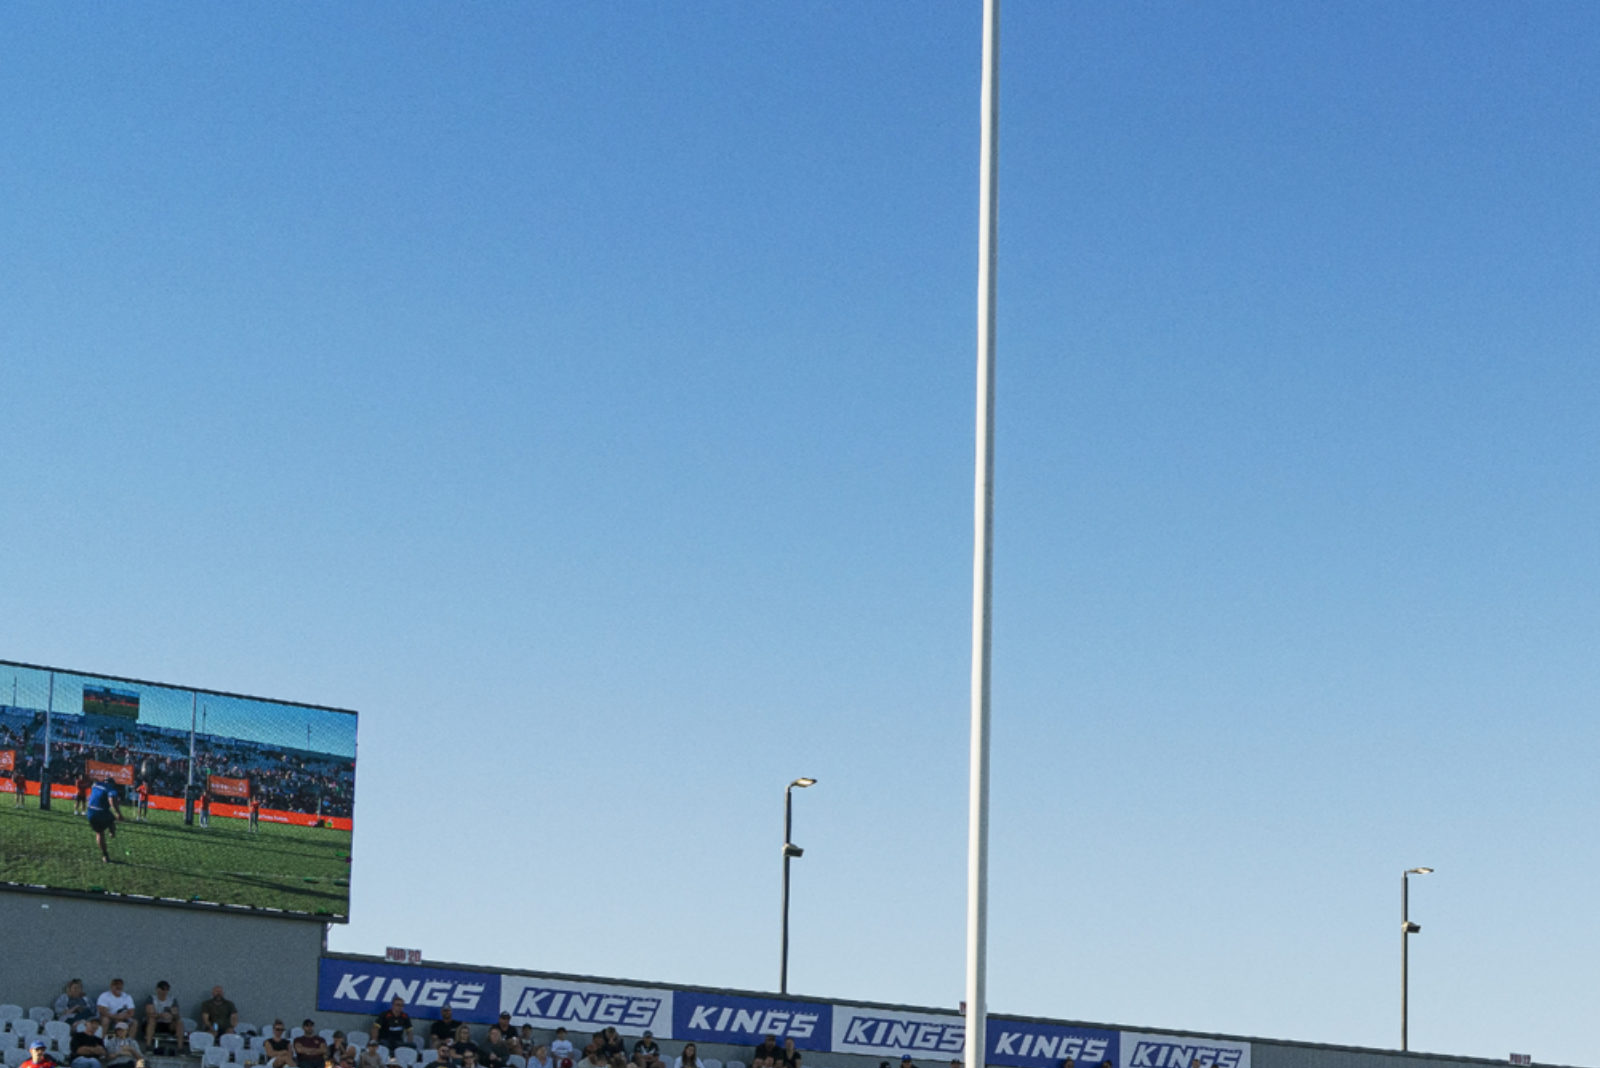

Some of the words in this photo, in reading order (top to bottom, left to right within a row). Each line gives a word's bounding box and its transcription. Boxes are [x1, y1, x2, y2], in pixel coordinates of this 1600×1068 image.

[333, 974, 485, 1010] KINGS
[514, 987, 661, 1026] KINGS
[688, 1006, 818, 1038] KINGS
[843, 1015, 966, 1053] KINGS
[994, 1032, 1108, 1060] KINGS
